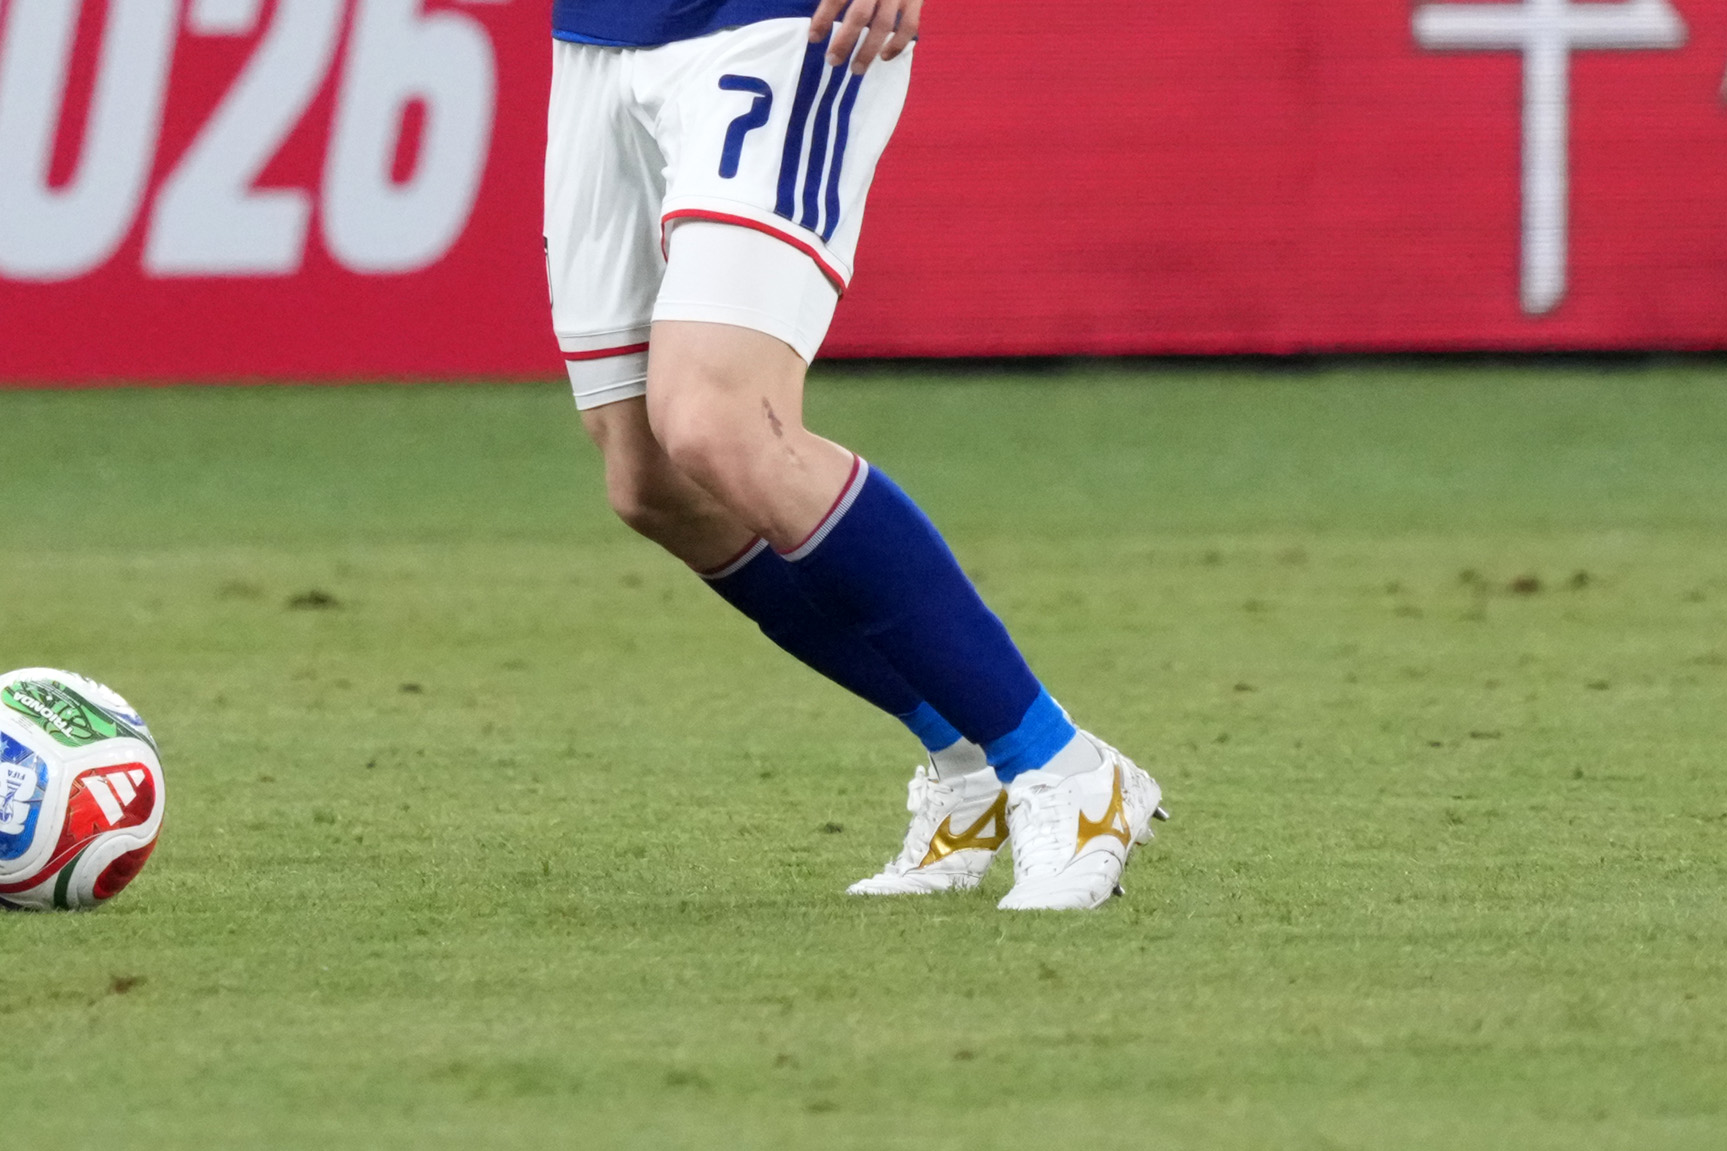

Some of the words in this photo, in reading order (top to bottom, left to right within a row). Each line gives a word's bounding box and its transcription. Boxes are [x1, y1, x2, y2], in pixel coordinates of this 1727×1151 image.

[718, 73, 774, 180] 7
[13, 692, 74, 738] TRIONDA
[7, 769, 27, 781] FIFA
